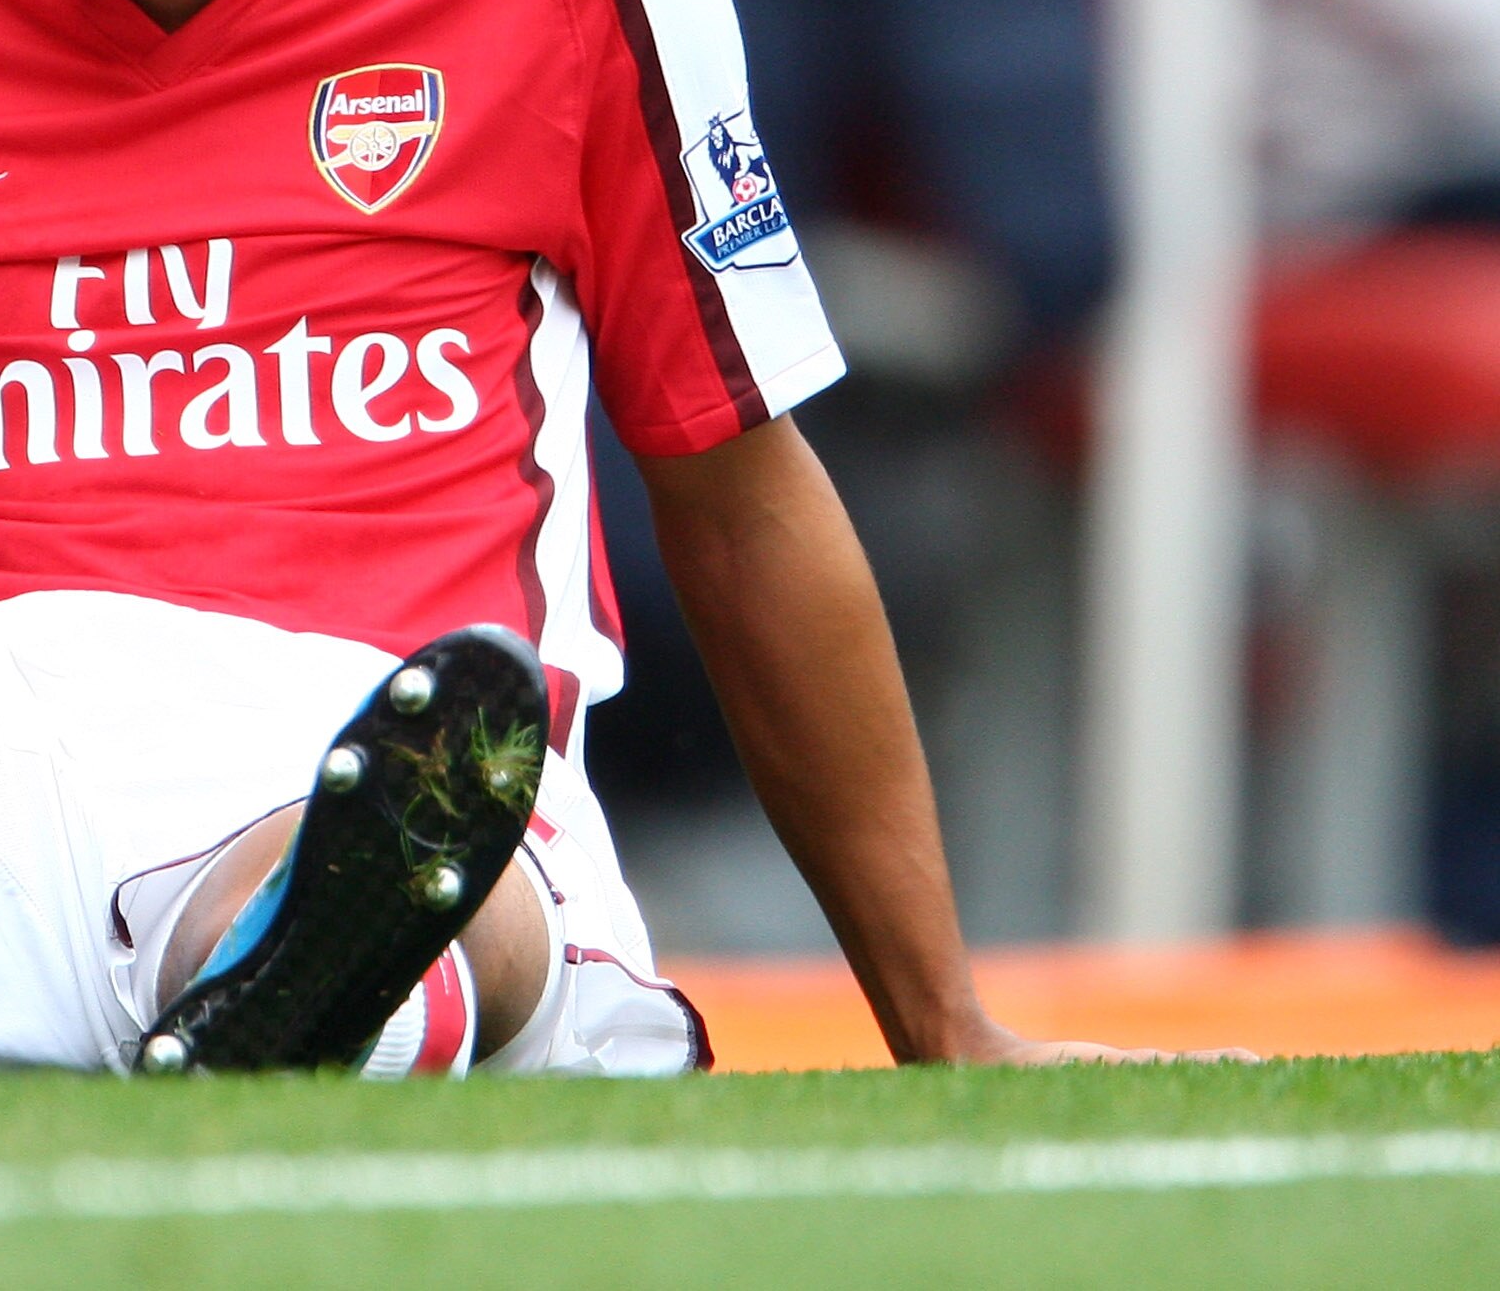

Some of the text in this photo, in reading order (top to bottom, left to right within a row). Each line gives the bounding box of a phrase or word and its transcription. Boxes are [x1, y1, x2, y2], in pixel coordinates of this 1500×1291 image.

[329, 89, 424, 115] Arsenal
[712, 194, 784, 248] BARCLA
[716, 226, 763, 259] PREMIER
[50, 238, 233, 330] Fly
